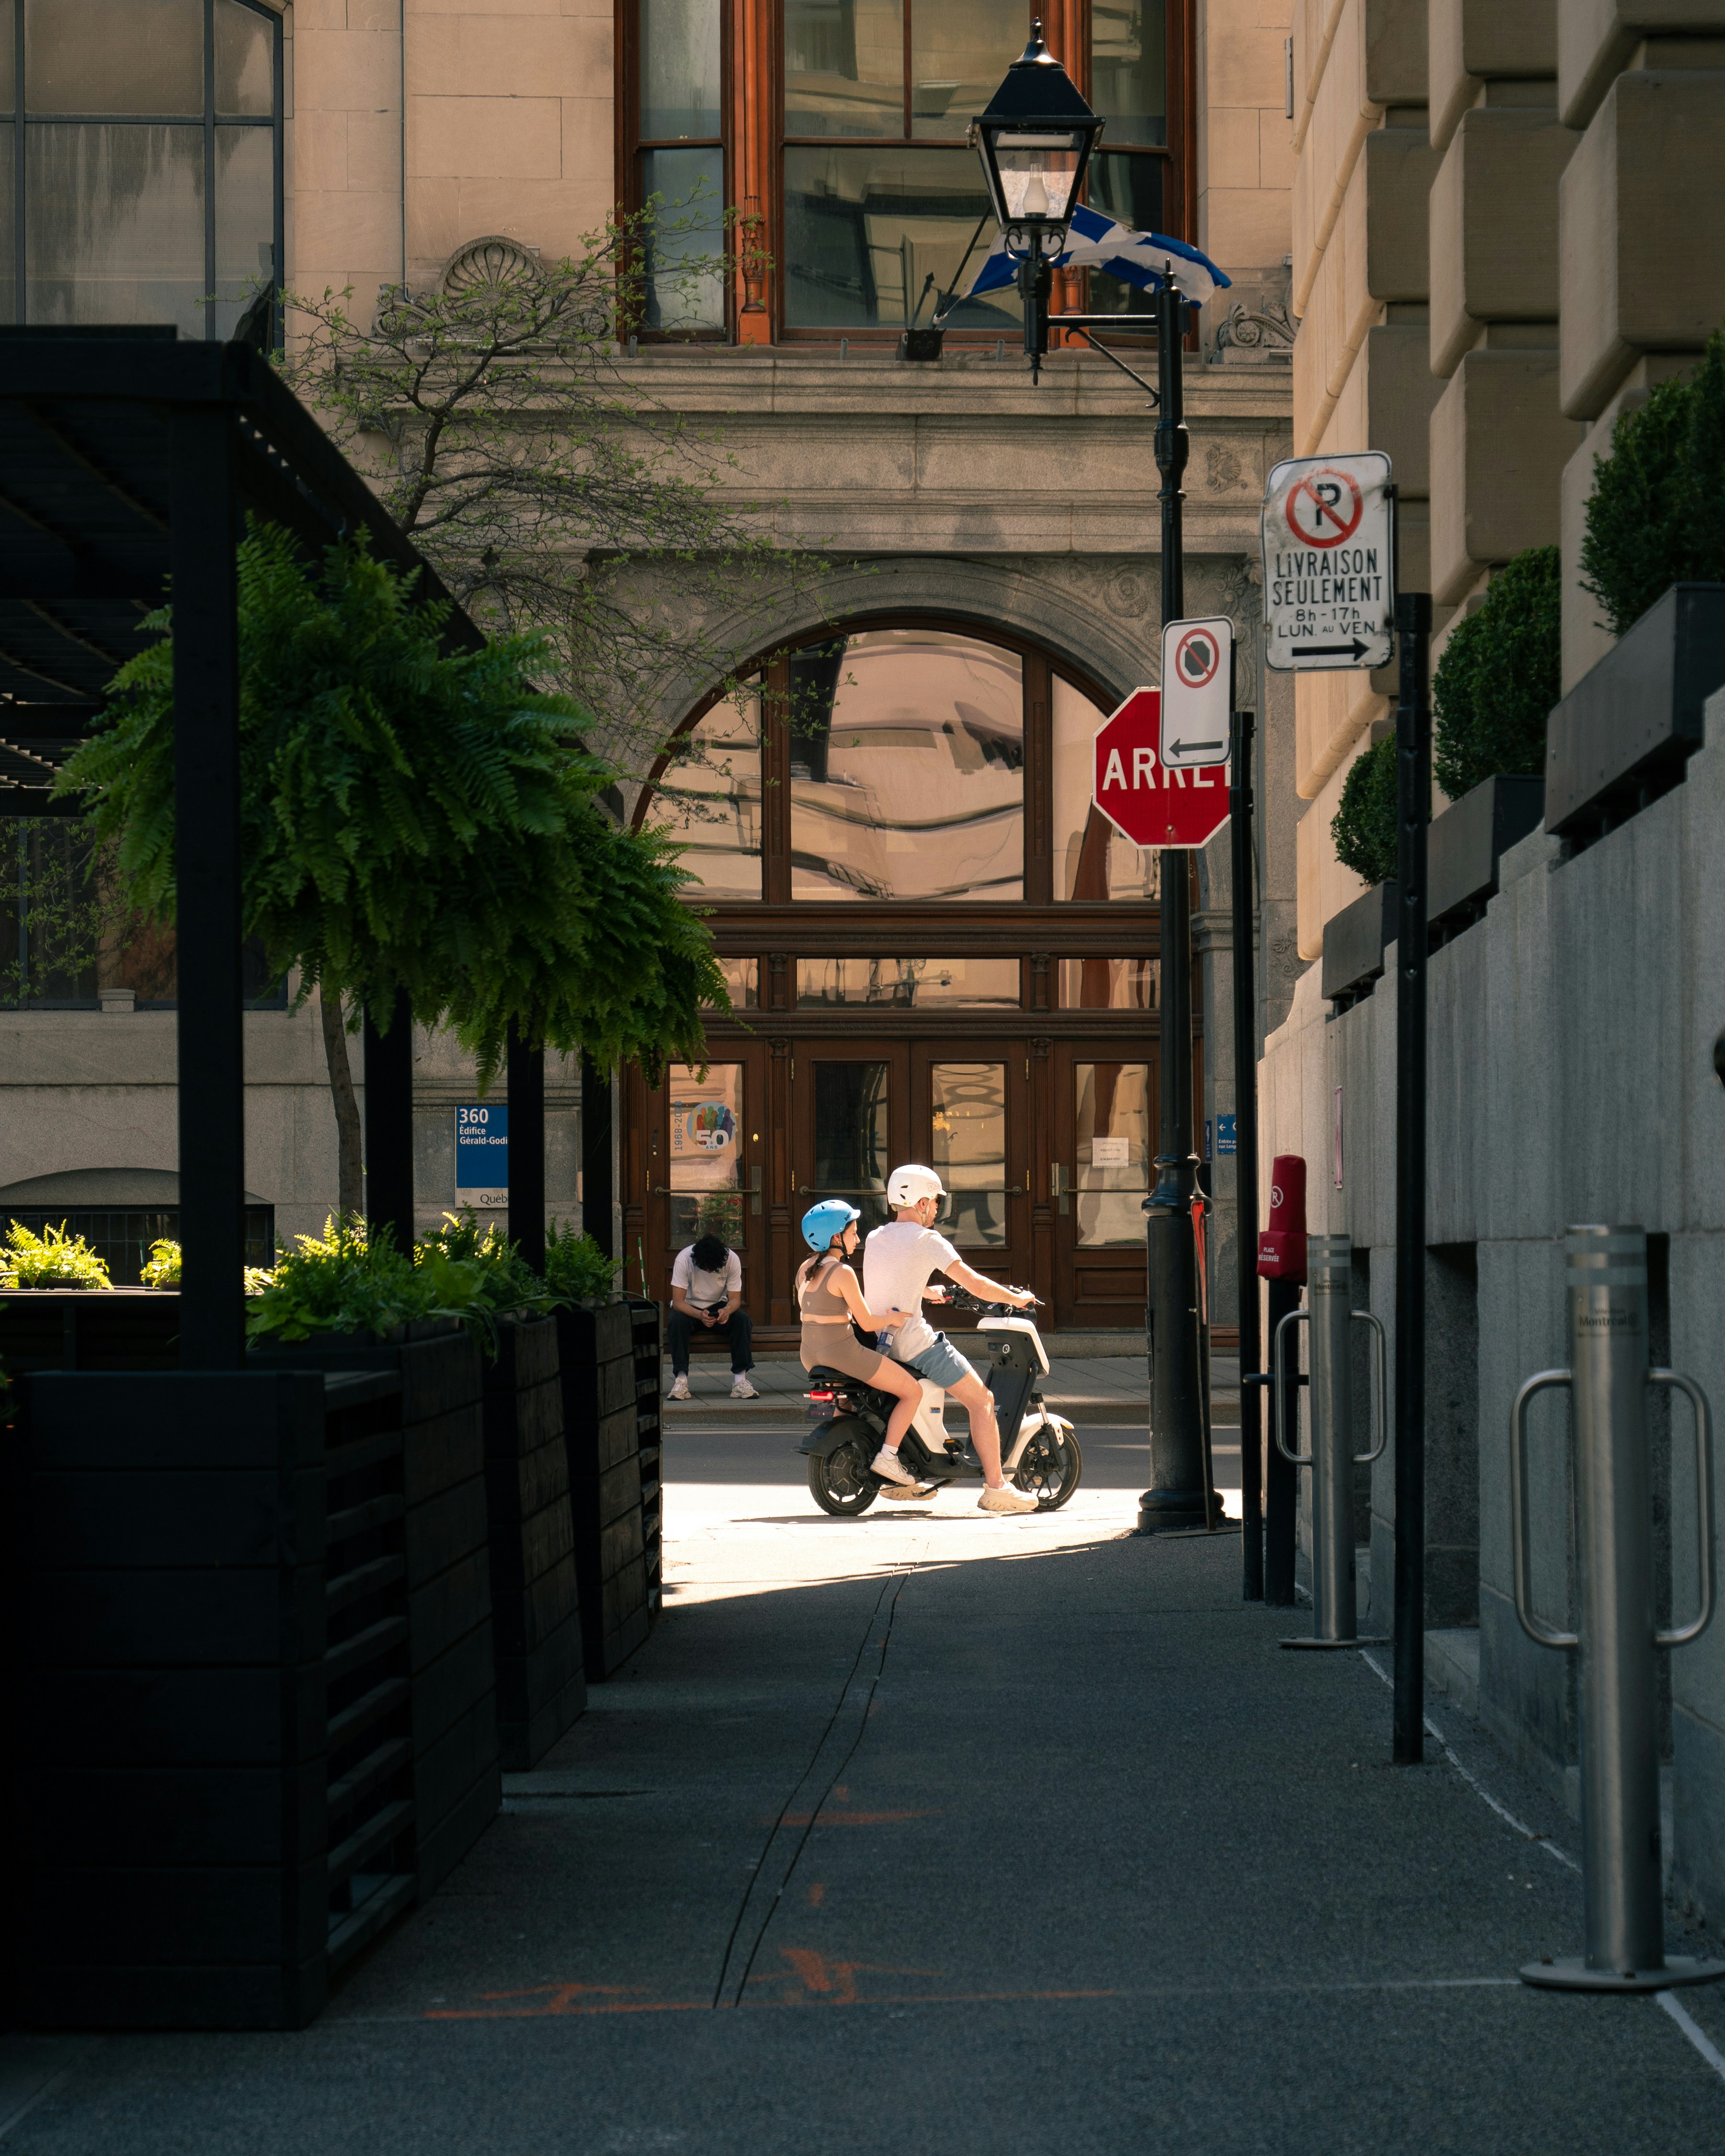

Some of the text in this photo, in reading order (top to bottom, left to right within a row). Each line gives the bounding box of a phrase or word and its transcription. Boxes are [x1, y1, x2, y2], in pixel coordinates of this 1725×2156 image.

[1273, 576, 1382, 605] SEULEMENT
[1279, 624, 1317, 638] LUN.
[459, 1108, 489, 1124] 360
[459, 1125, 486, 1135] Édifice
[674, 1101, 683, 1151] 1968-2018
[696, 1129, 729, 1148] 50
[480, 1194, 508, 1206] Québ
[1258, 1253, 1279, 1262] RÉSERVÉE
